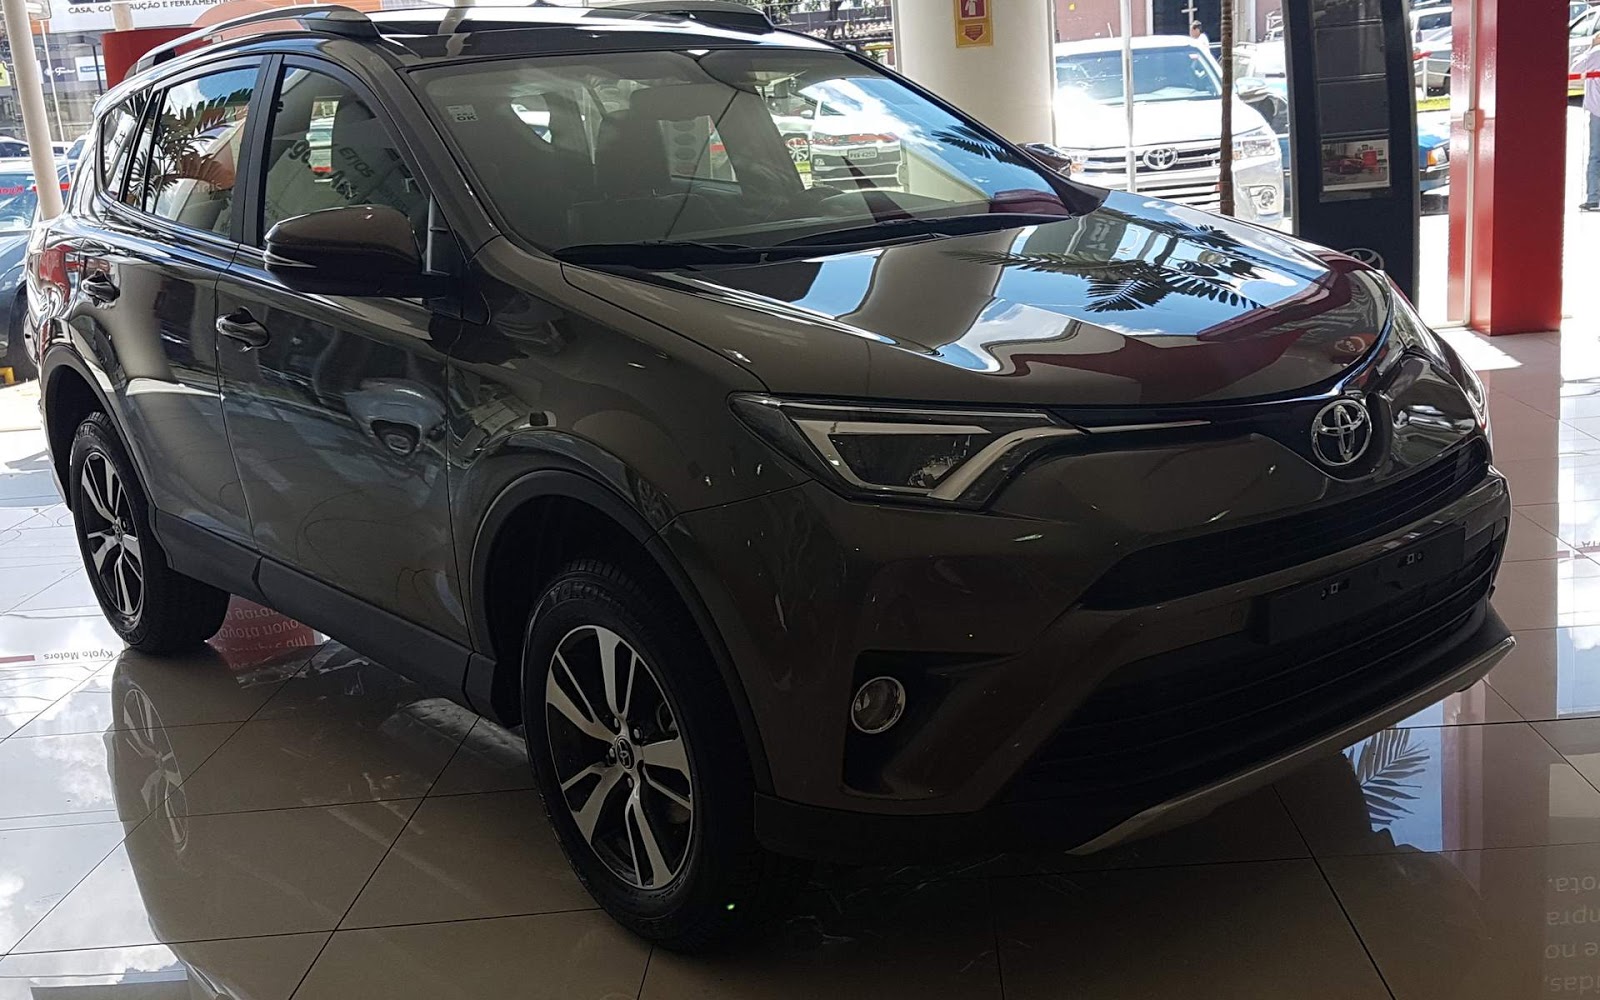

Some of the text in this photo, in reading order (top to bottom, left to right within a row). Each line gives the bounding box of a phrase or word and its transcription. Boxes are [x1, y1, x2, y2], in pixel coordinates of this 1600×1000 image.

[68, 6, 95, 14] CASA,
[339, 146, 376, 178] ETIOS
[43, 648, 114, 660] Kyoto Motors
